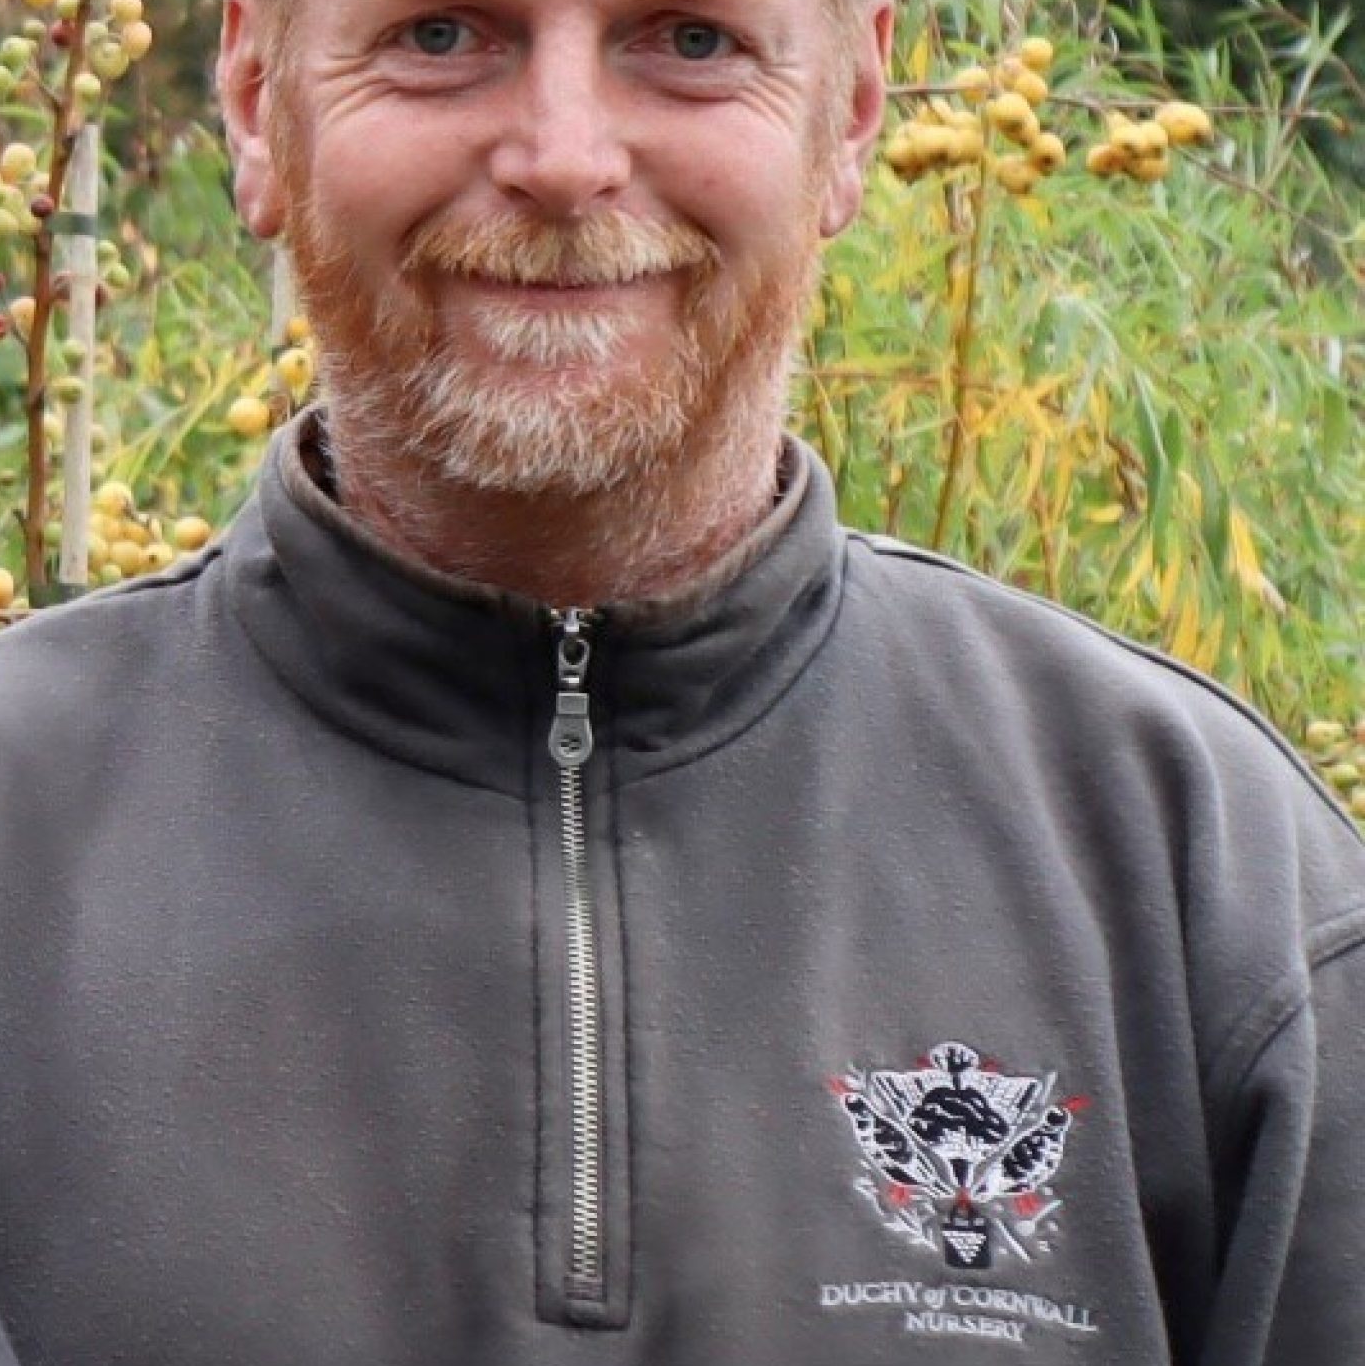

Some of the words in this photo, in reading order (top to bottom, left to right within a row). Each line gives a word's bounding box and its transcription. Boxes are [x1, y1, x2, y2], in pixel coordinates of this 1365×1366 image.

[820, 1281, 922, 1306] DUCHY
[924, 1289, 947, 1309] of
[950, 1285, 1099, 1332] CORNWALL
[905, 1309, 1026, 1342] NURSERY
